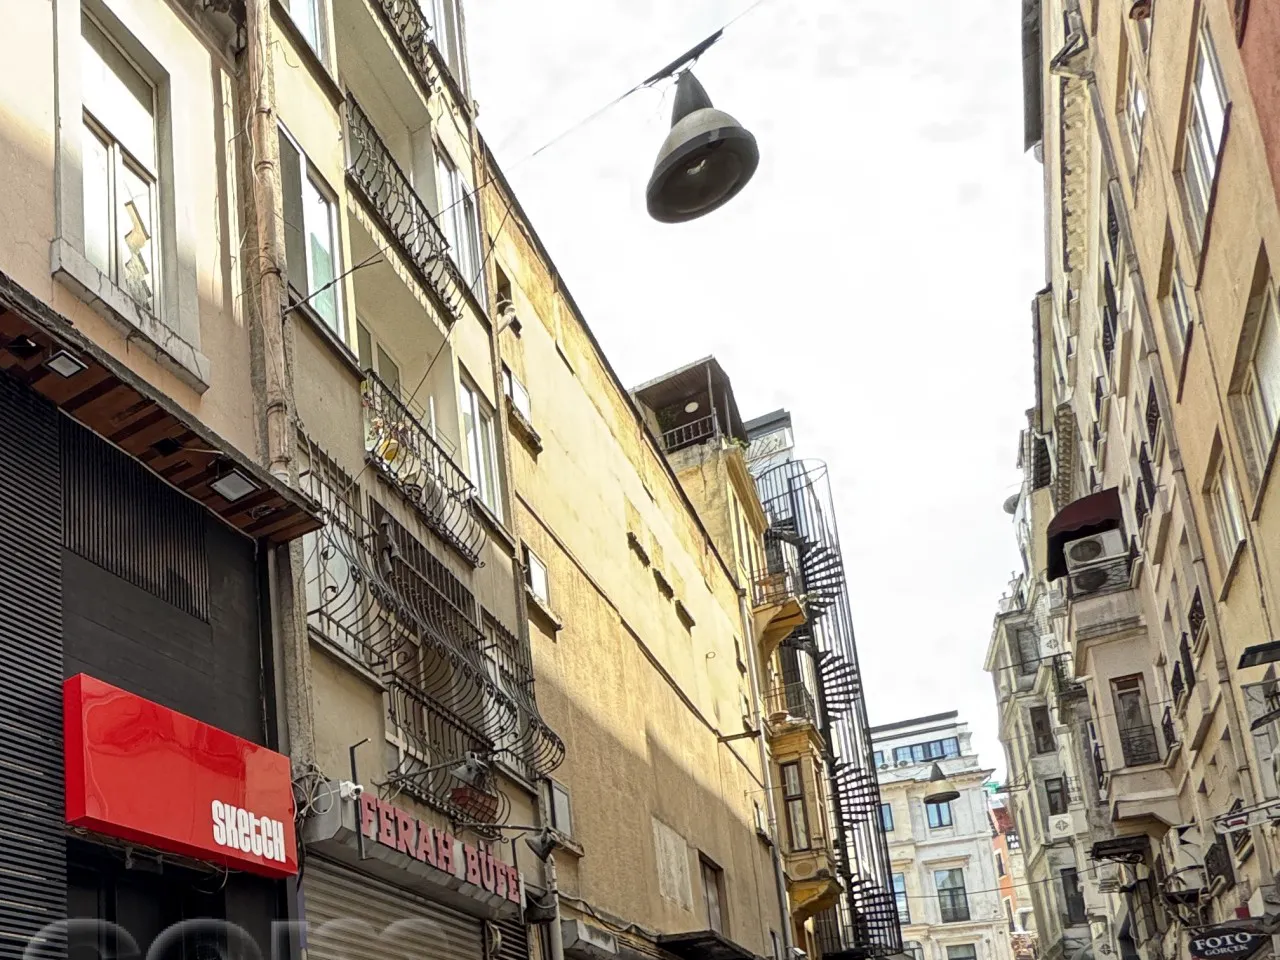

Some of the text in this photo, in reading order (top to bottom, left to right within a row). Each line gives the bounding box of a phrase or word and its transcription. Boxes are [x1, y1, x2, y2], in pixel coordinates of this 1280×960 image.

[359, 791, 520, 905] FERAH BÜFE
[1193, 932, 1252, 951] FOTO
